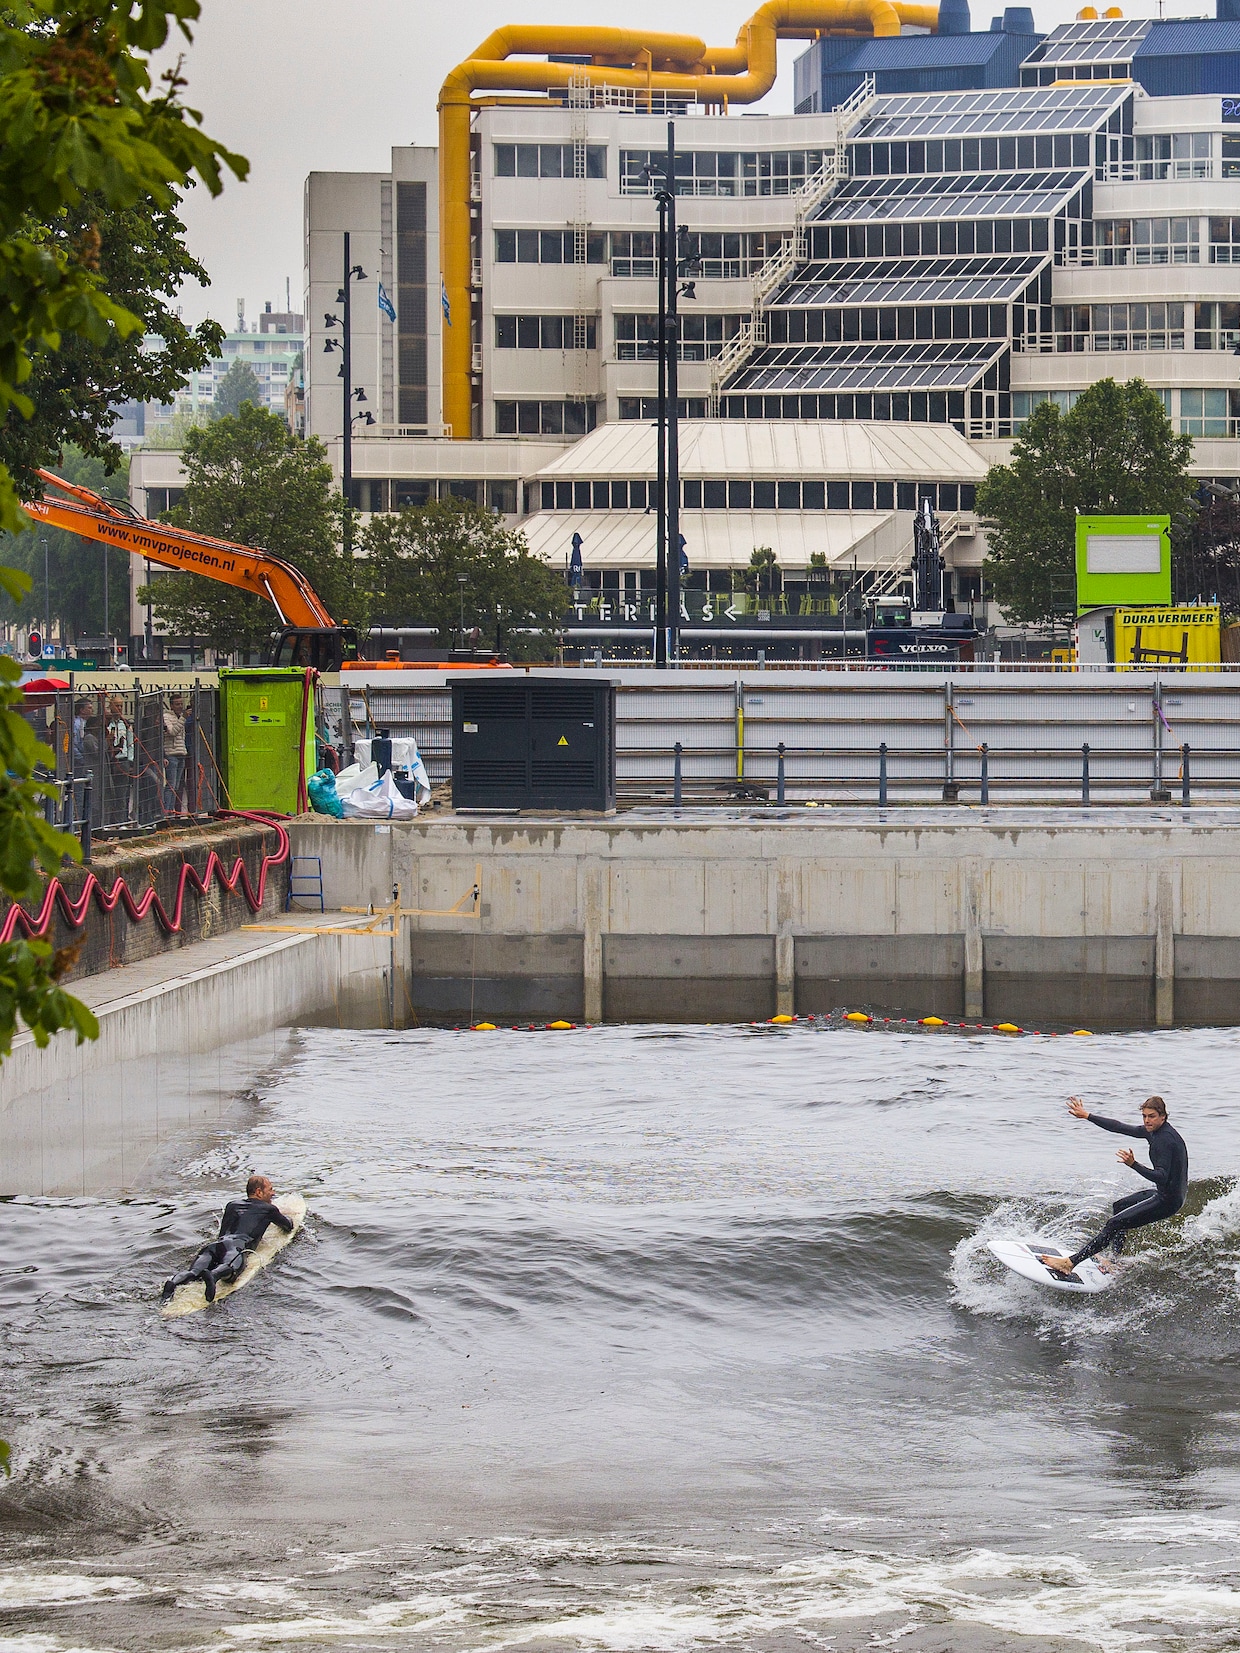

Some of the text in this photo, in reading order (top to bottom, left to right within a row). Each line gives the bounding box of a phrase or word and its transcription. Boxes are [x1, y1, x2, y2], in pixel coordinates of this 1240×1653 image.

[97, 523, 236, 572] www.vmvprojecten.nl
[1123, 614, 1213, 624] DURA VERMEER
[899, 644, 948, 653] VOLVO
